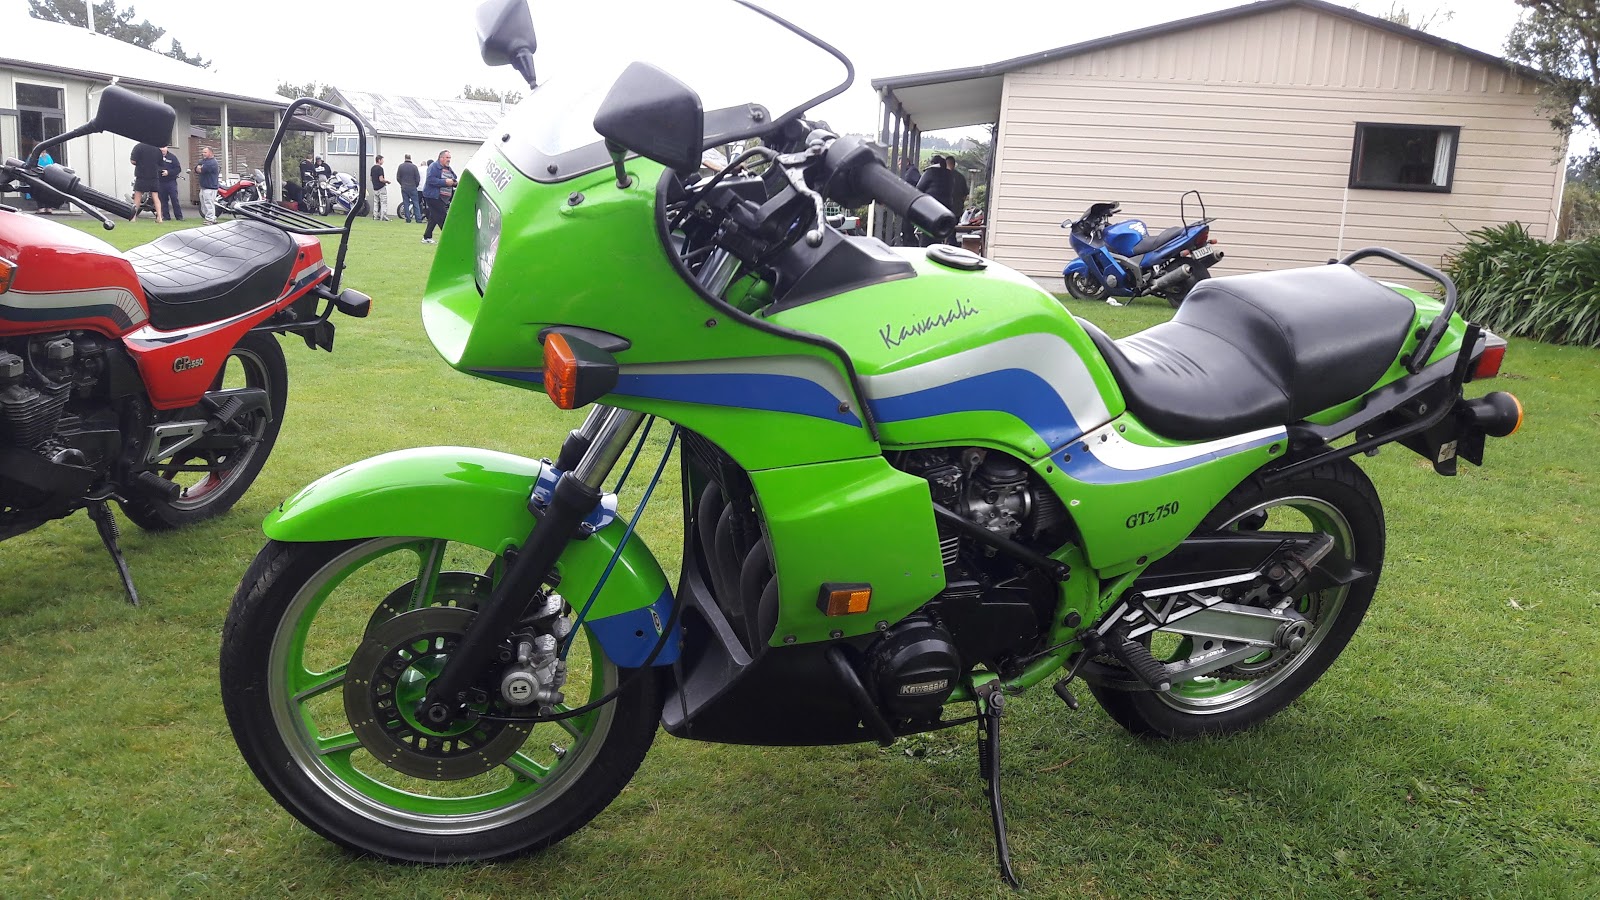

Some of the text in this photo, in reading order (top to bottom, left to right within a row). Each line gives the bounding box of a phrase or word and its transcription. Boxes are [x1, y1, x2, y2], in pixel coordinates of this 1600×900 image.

[879, 298, 979, 350] Kawasaki
[1125, 500, 1180, 529] GTz750
[901, 679, 949, 694] Kawasaki
